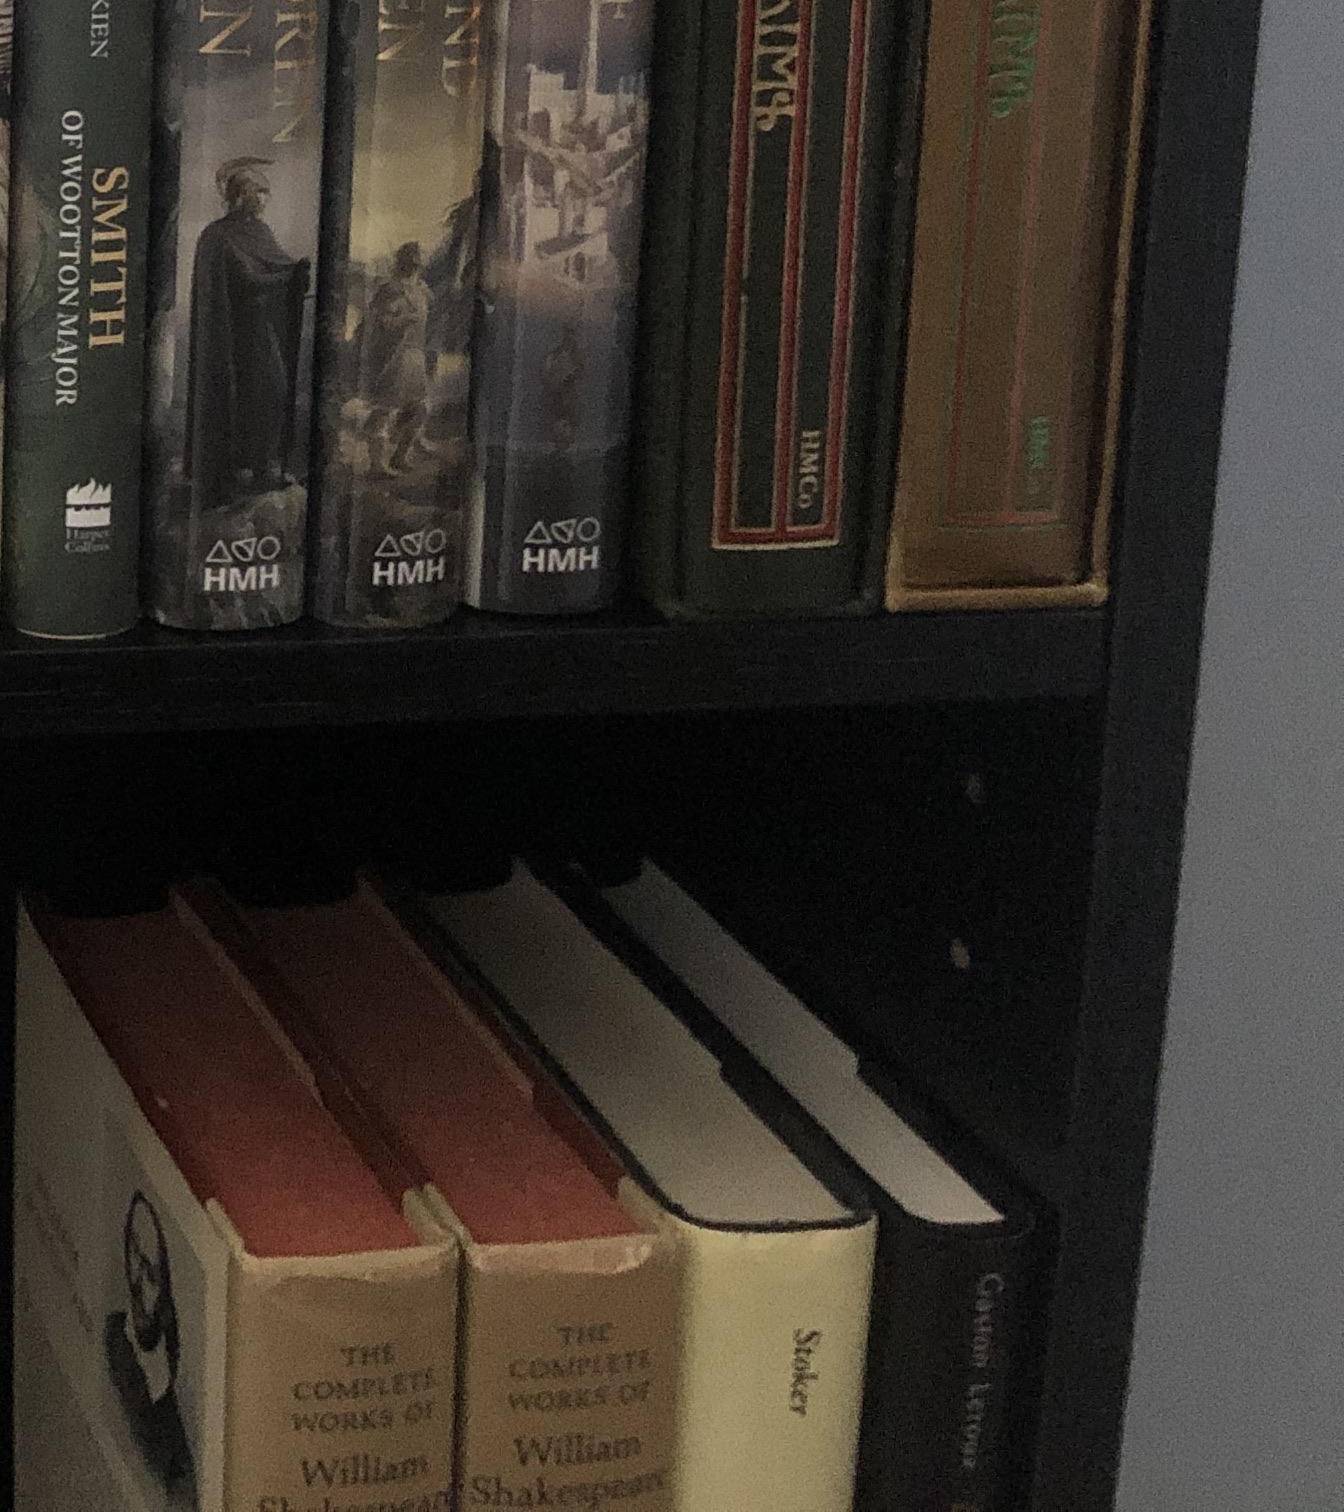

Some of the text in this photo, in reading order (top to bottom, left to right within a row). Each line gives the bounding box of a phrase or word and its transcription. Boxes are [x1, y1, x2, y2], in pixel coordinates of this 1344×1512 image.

[50, 109, 84, 406] OF WOOTTON MAJOR
[88, 167, 131, 351] SMITH
[372, 557, 446, 586] HMH
[522, 547, 601, 574] HMH
[203, 564, 280, 593] HMH
[509, 1348, 651, 1381] COMPLETE
[788, 1327, 824, 1419] Stoker
[509, 1386, 608, 1412] WORKS
[291, 1407, 394, 1433] WORKS
[512, 1431, 643, 1467] William
[299, 1452, 431, 1489] William
